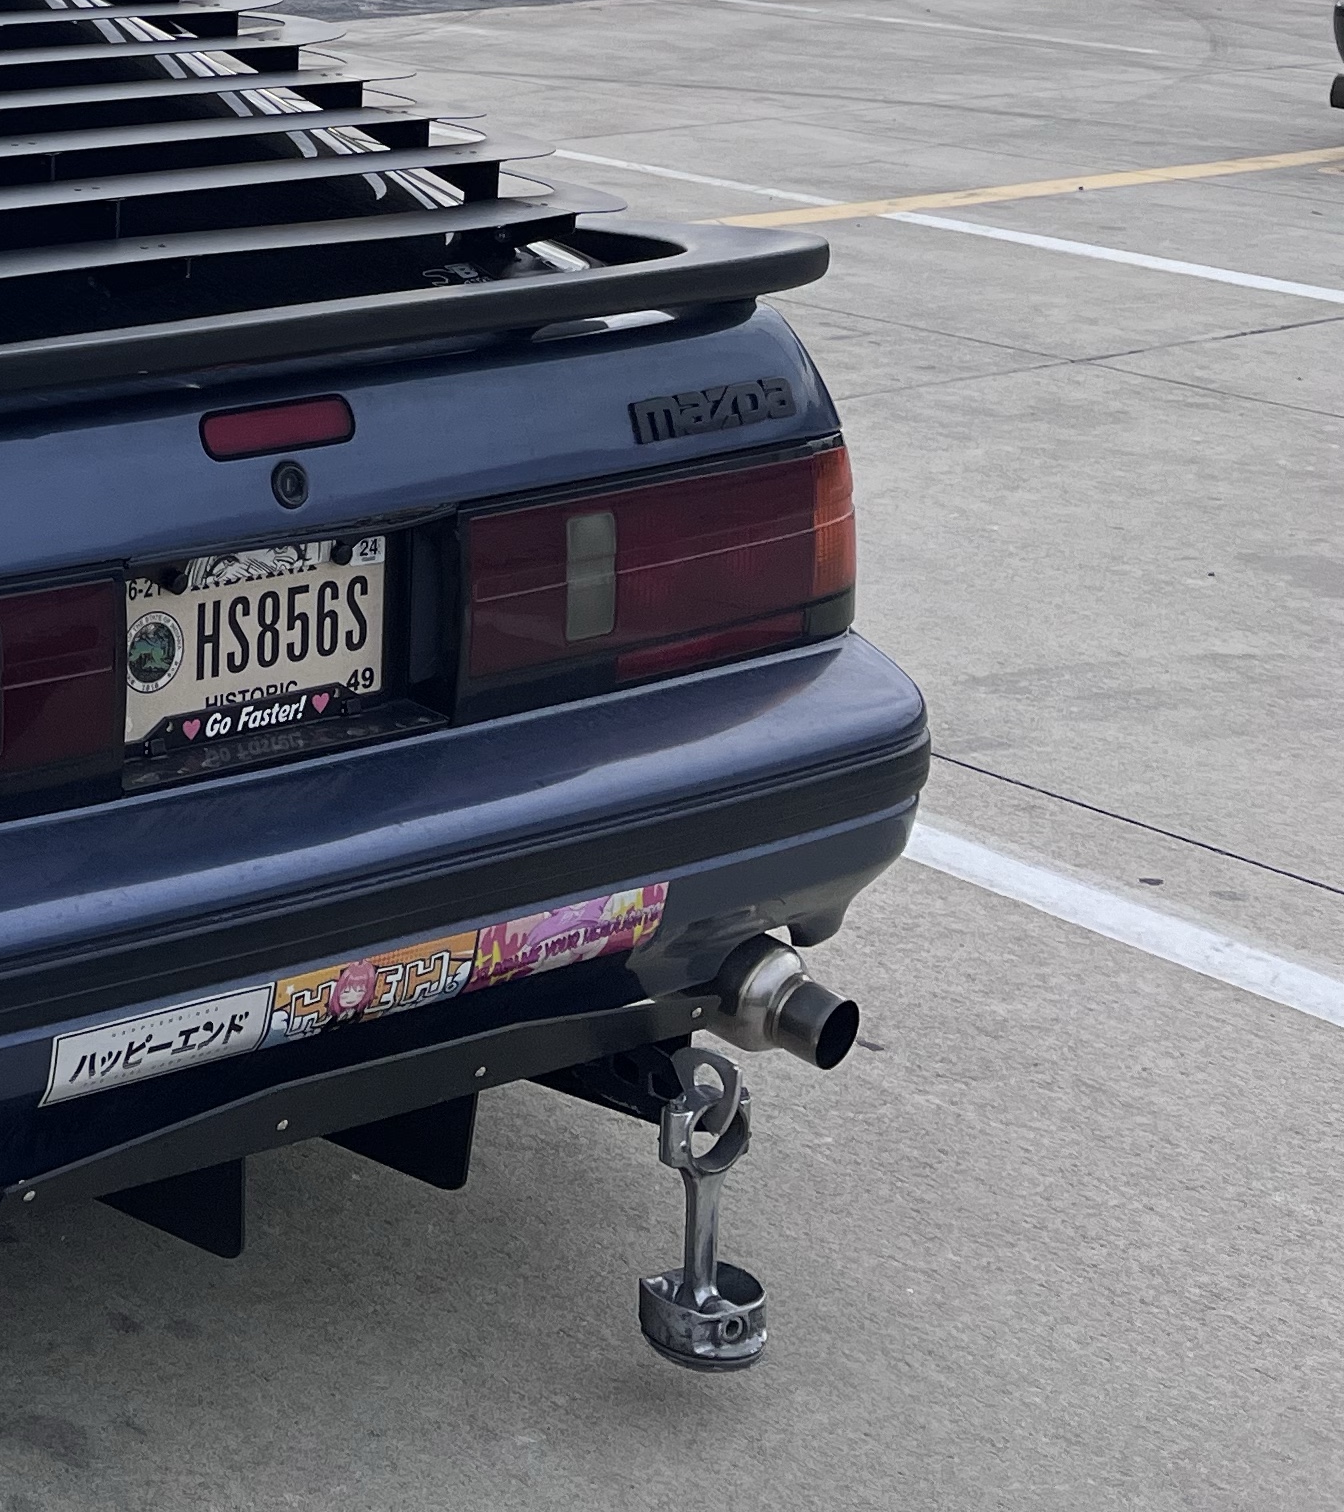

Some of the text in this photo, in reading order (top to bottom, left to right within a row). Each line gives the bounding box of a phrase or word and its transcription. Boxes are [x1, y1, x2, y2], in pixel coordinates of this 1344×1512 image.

[628, 377, 798, 445] mazda
[359, 538, 379, 557] 24
[196, 575, 369, 681] HS856S
[346, 666, 375, 692] 49
[205, 695, 308, 738] Go Faster!
[68, 1011, 251, 1085] ハッピーエンド
